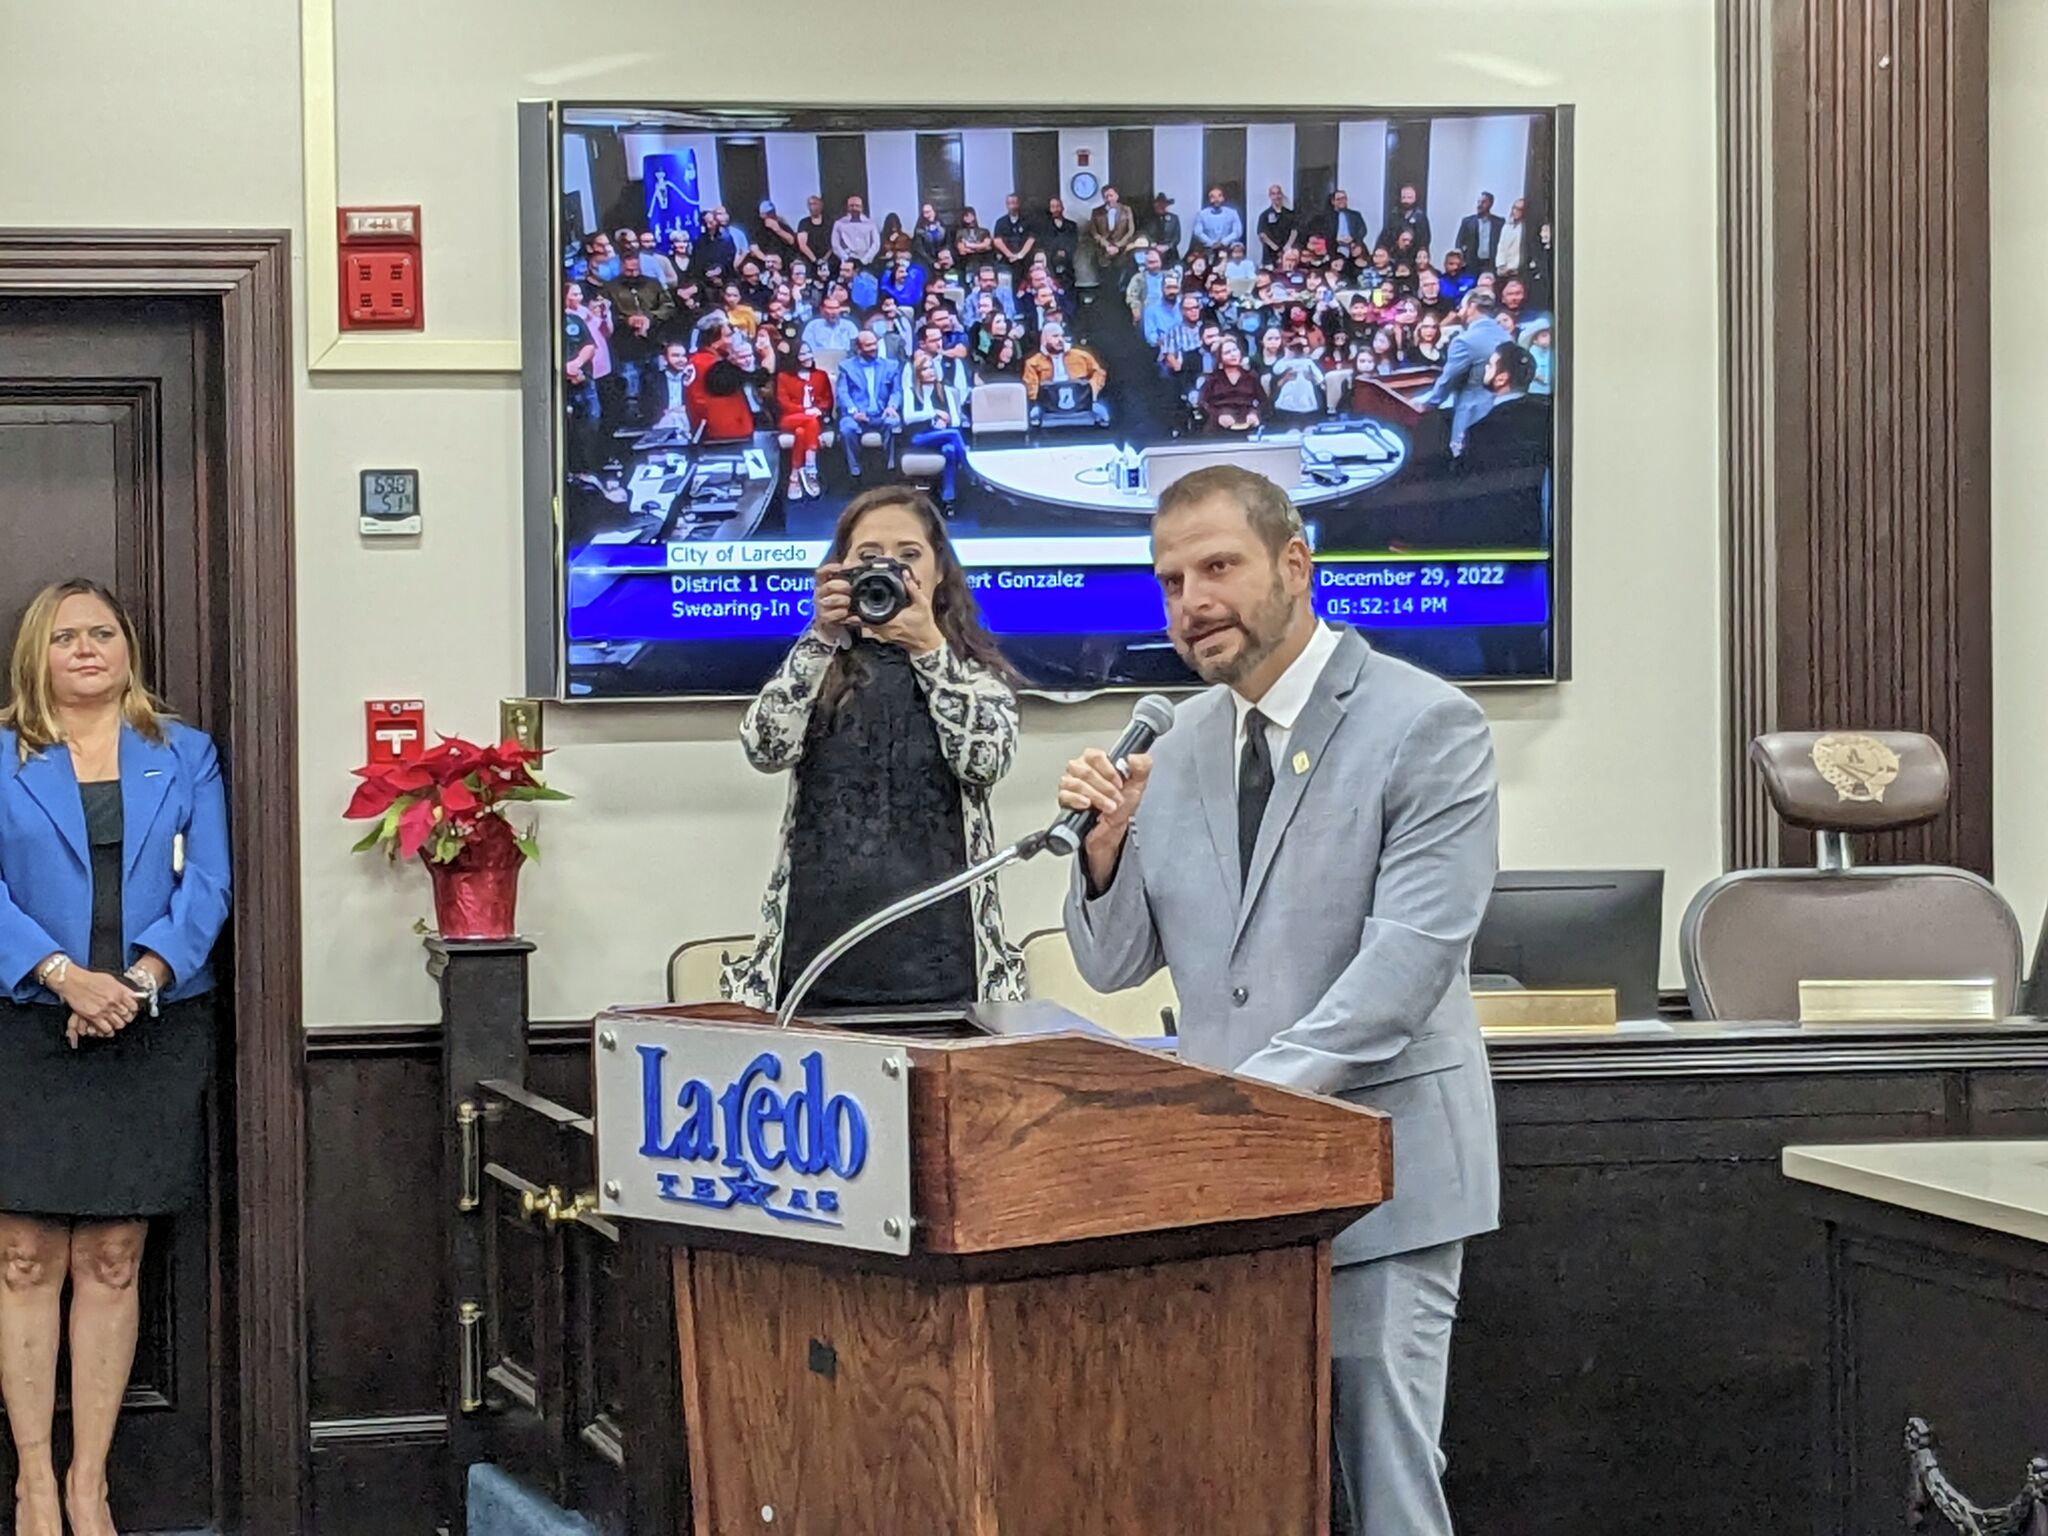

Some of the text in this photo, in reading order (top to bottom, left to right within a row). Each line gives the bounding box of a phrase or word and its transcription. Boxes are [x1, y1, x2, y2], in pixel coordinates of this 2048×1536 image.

[671, 545, 807, 565] City of Laredo
[671, 575, 742, 593] District
[749, 575, 758, 592] 1
[998, 570, 1085, 588] Gonzalez
[1320, 567, 1505, 587] December 29, 2022
[672, 599, 790, 620] Swearing-In
[1327, 597, 1448, 614] 05:52:14 PM
[635, 1045, 867, 1179] Laredo
